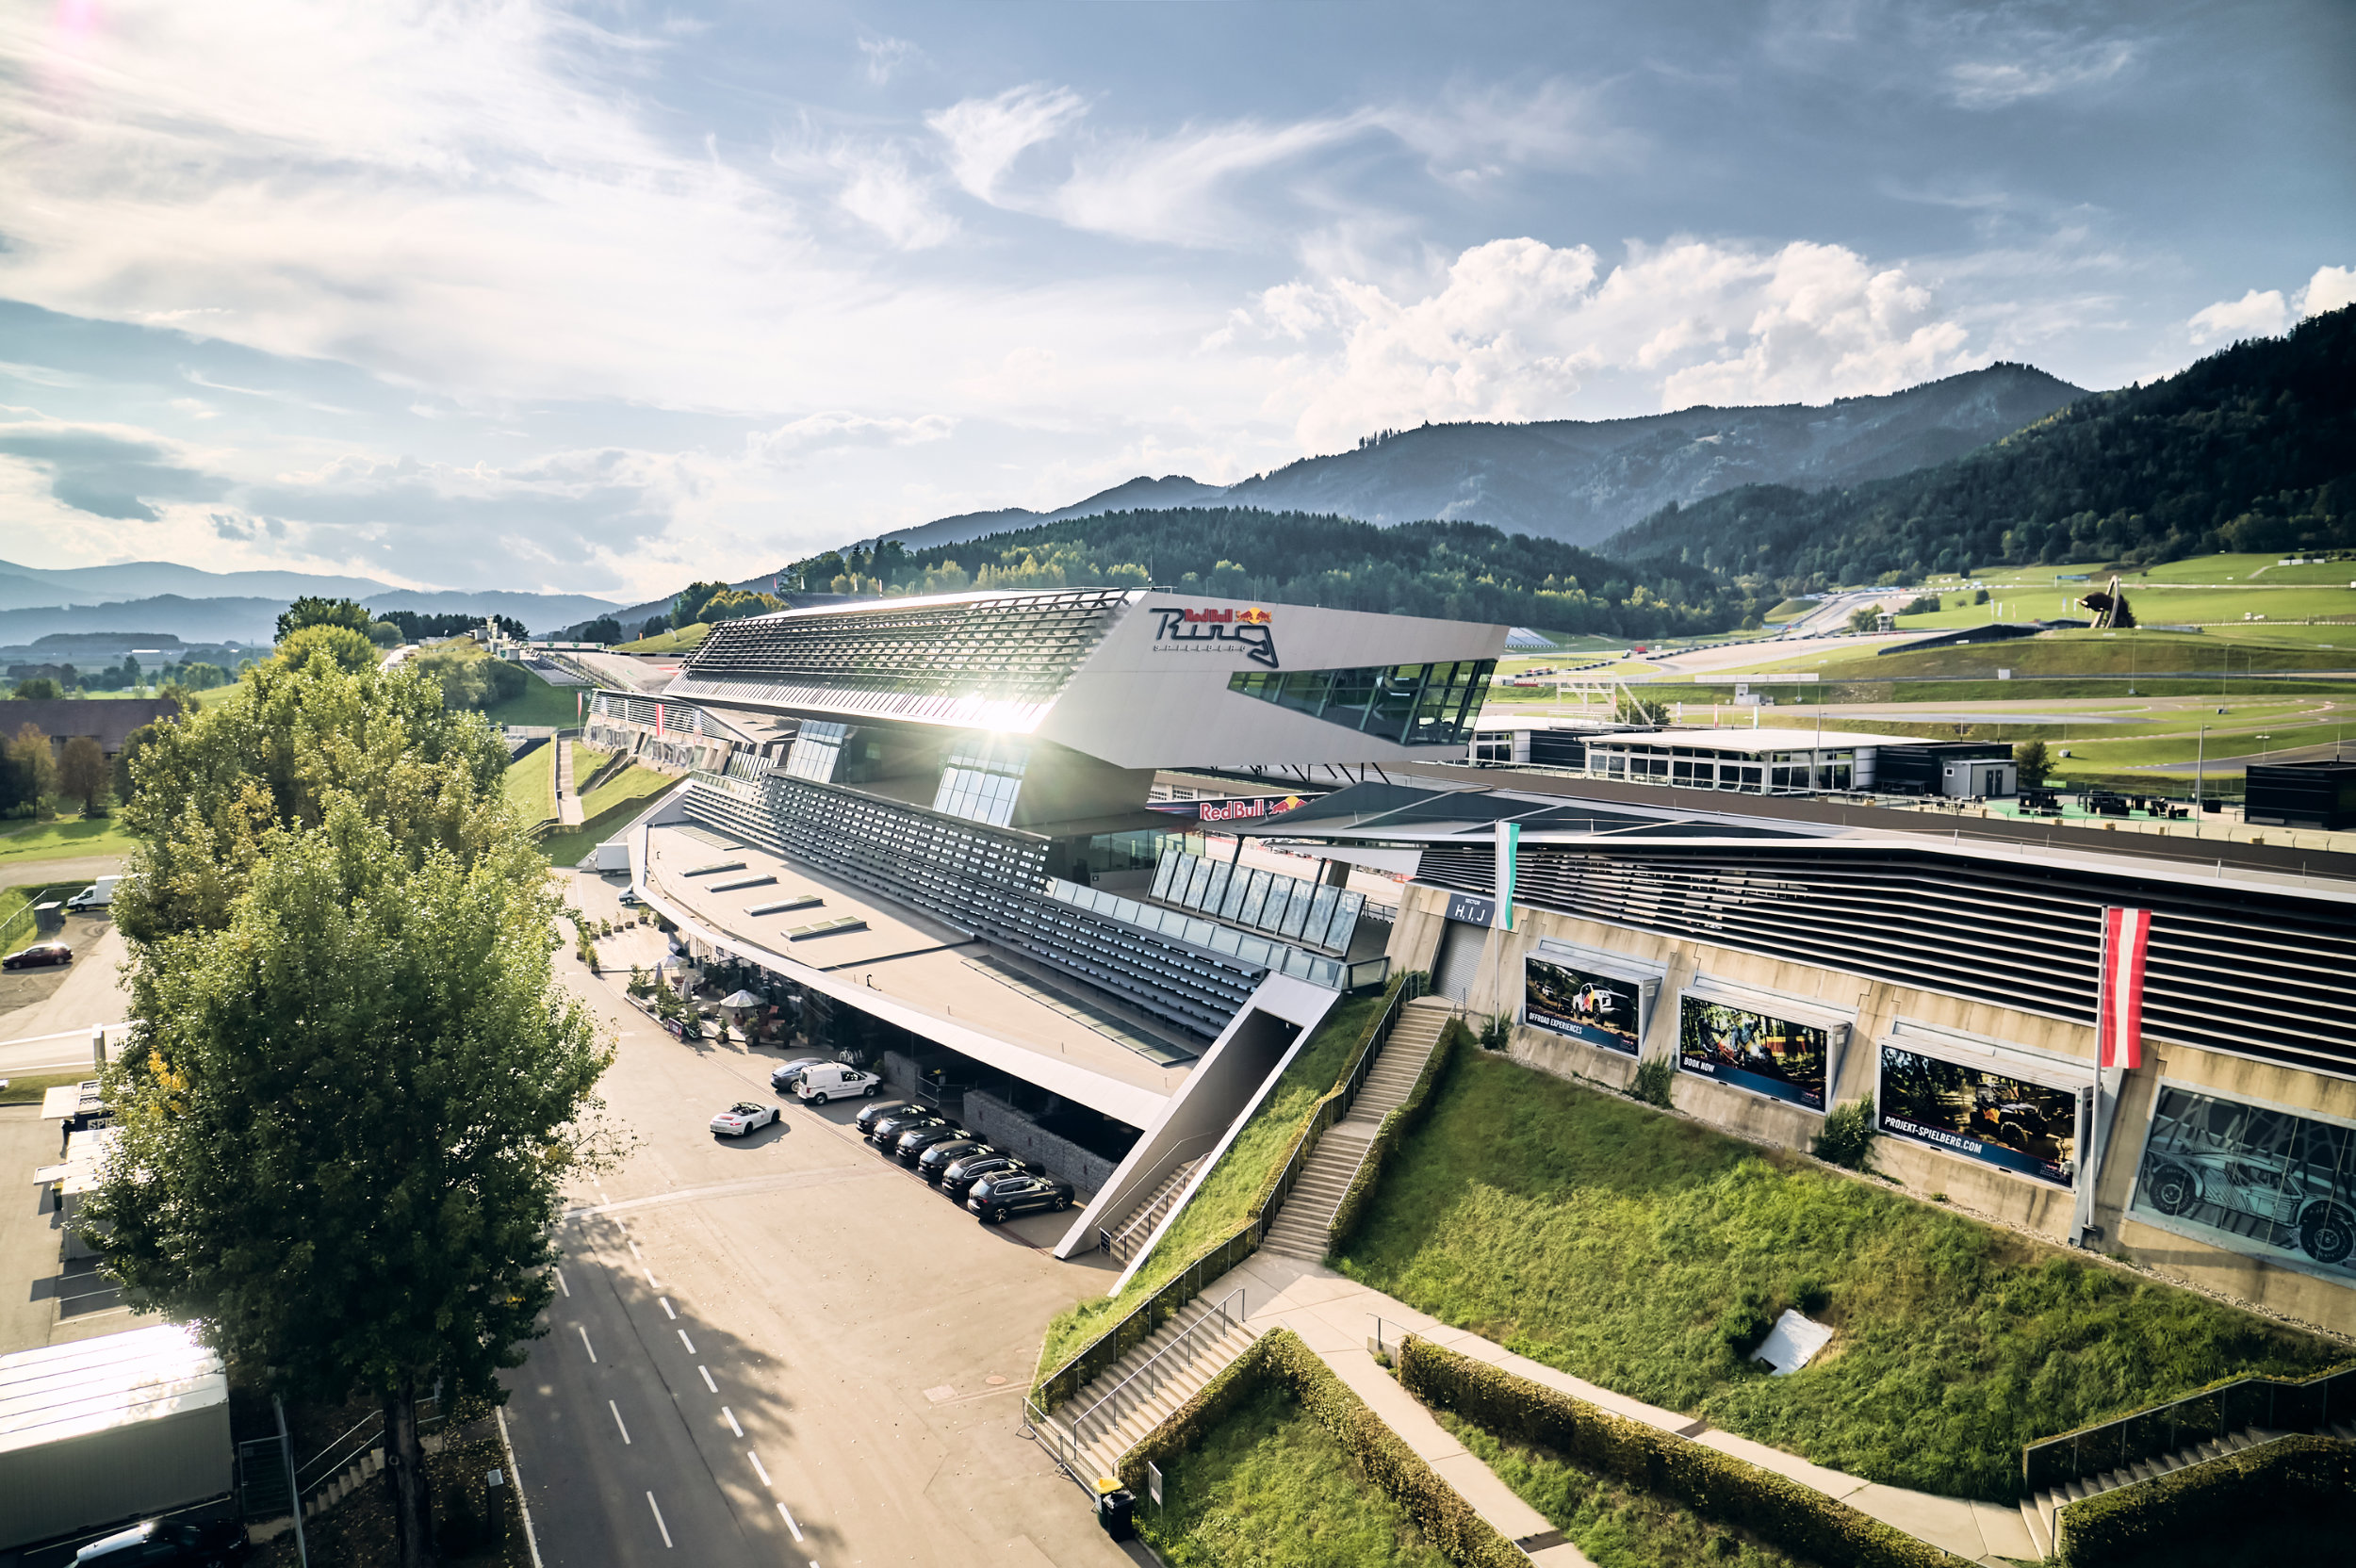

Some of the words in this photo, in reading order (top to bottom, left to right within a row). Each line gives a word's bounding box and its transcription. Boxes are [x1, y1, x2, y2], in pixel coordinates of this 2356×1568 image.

[1185, 609, 1208, 622] Red
[1209, 609, 1233, 622] Bull
[1200, 800, 1233, 821] Red
[1233, 798, 1264, 820] Bull
[1477, 909, 1485, 922] J
[1529, 1012, 1549, 1024] OFFROAD
[1550, 1019, 1582, 1035] EXPERIENCES
[1683, 1056, 1701, 1069] BOOK
[1700, 1061, 1715, 1072] NOW
[1885, 1116, 1982, 1153] PROJEKT-SPIELBERG.COM
